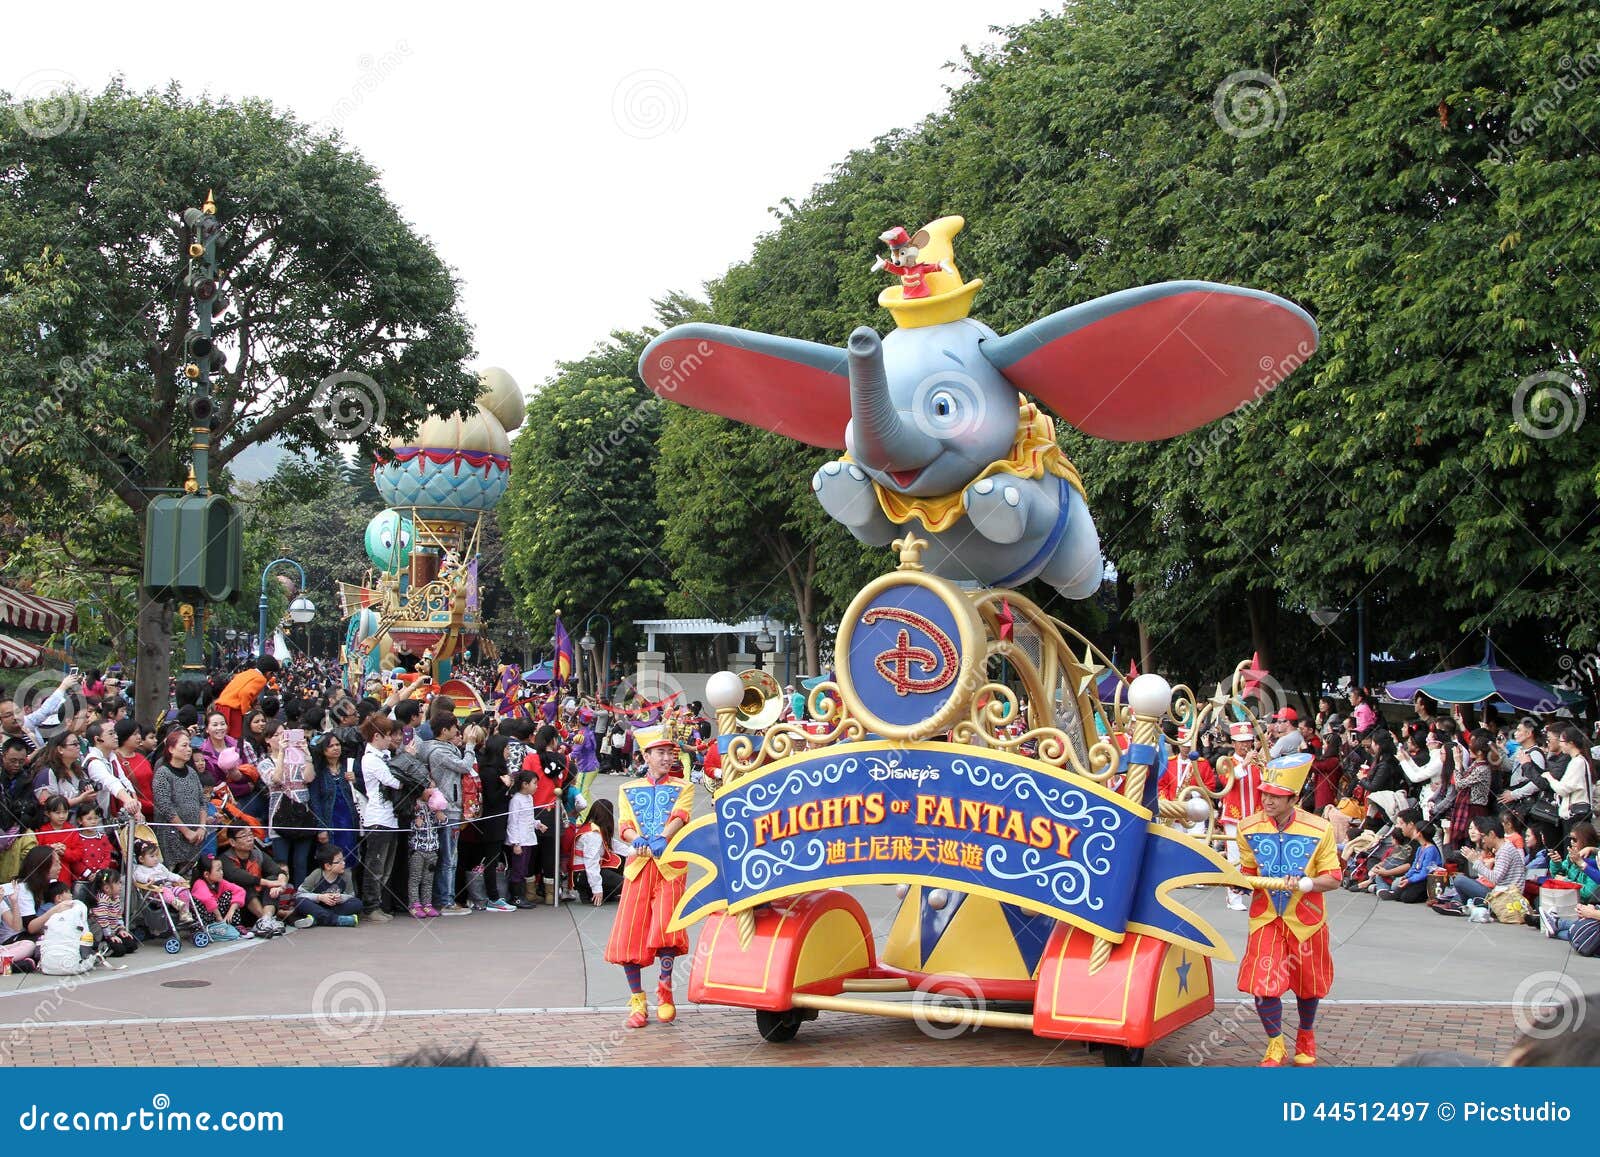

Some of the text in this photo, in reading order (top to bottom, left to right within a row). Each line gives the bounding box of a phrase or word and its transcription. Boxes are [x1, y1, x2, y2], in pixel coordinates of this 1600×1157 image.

[753, 792, 1081, 859] FLIGHTS OF FANTASY
[825, 835, 985, 872] 迪士尼飛天巡遊
